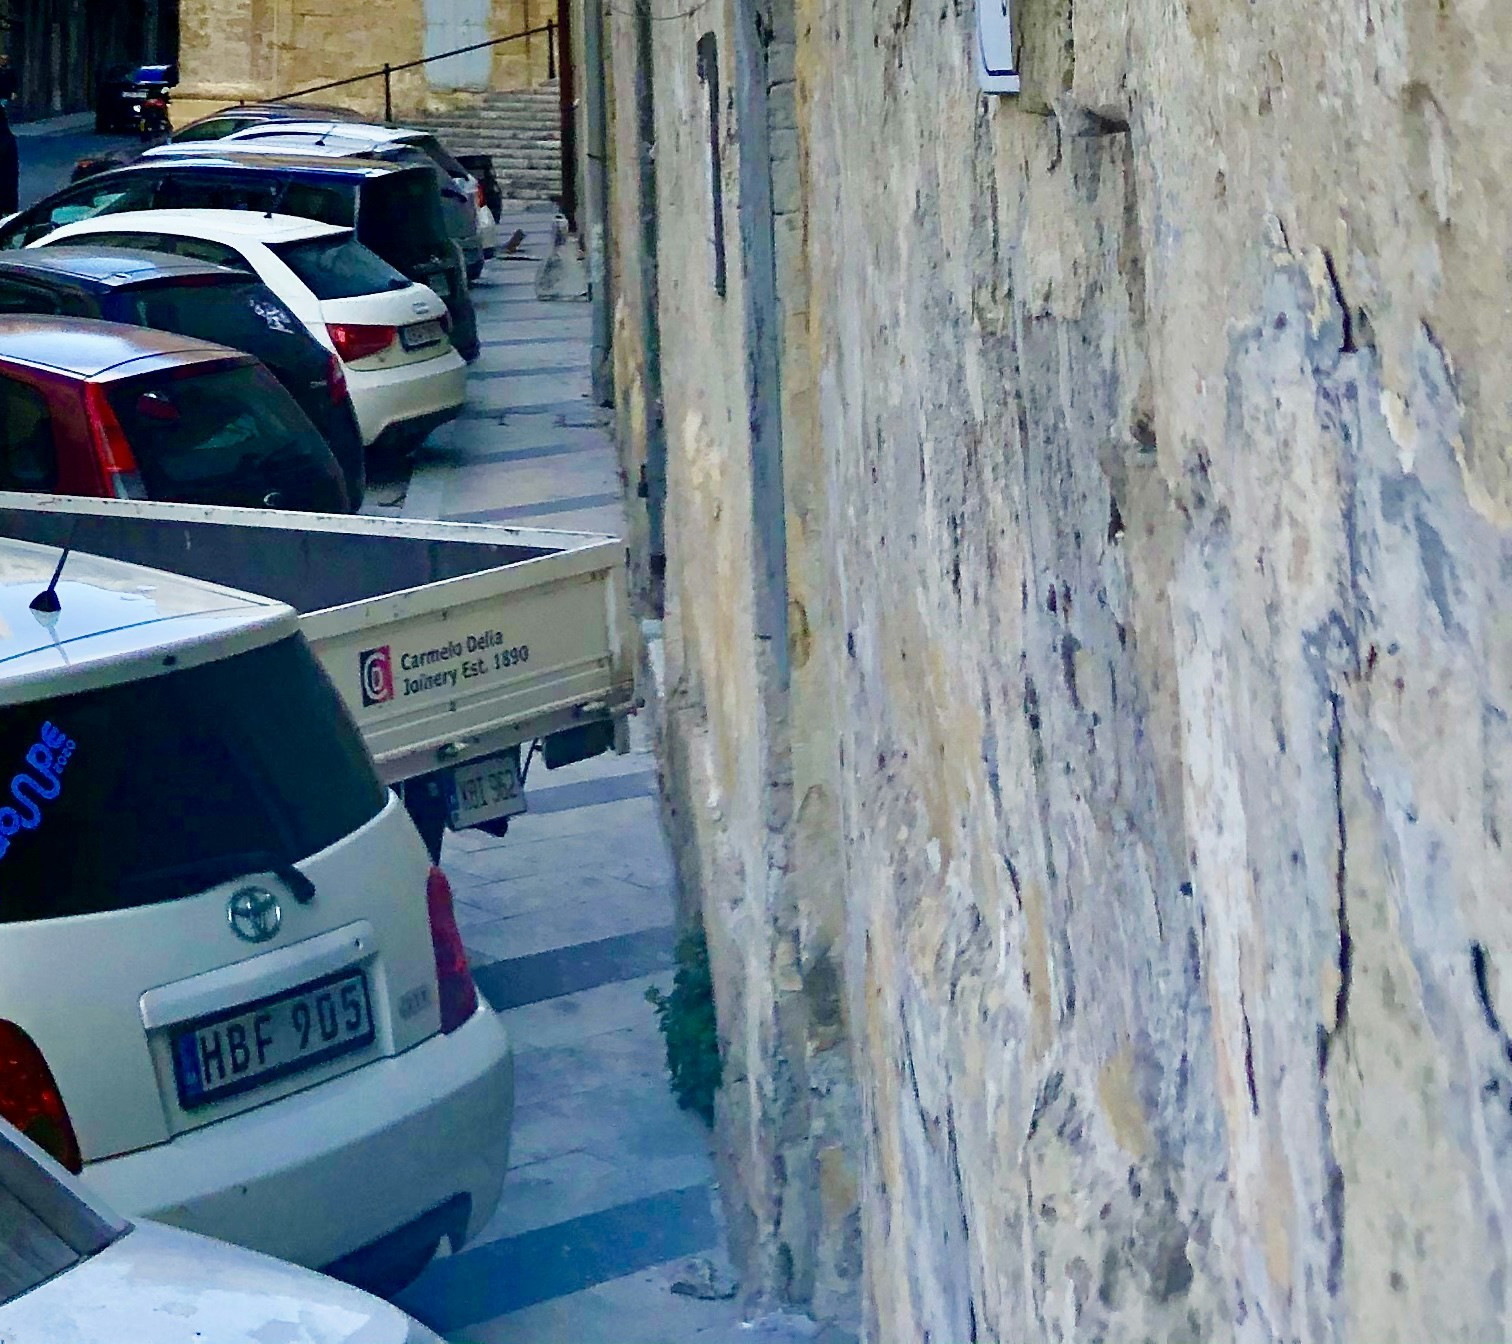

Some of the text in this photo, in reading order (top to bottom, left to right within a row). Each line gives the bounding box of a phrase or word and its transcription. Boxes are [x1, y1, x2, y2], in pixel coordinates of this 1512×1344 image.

[400, 640, 463, 671] Carmelo
[403, 667, 457, 696] Joinery
[493, 644, 530, 670] 1890
[52, 738, 77, 775] 2020
[200, 1012, 274, 1085] HBF
[291, 984, 363, 1051] 905
